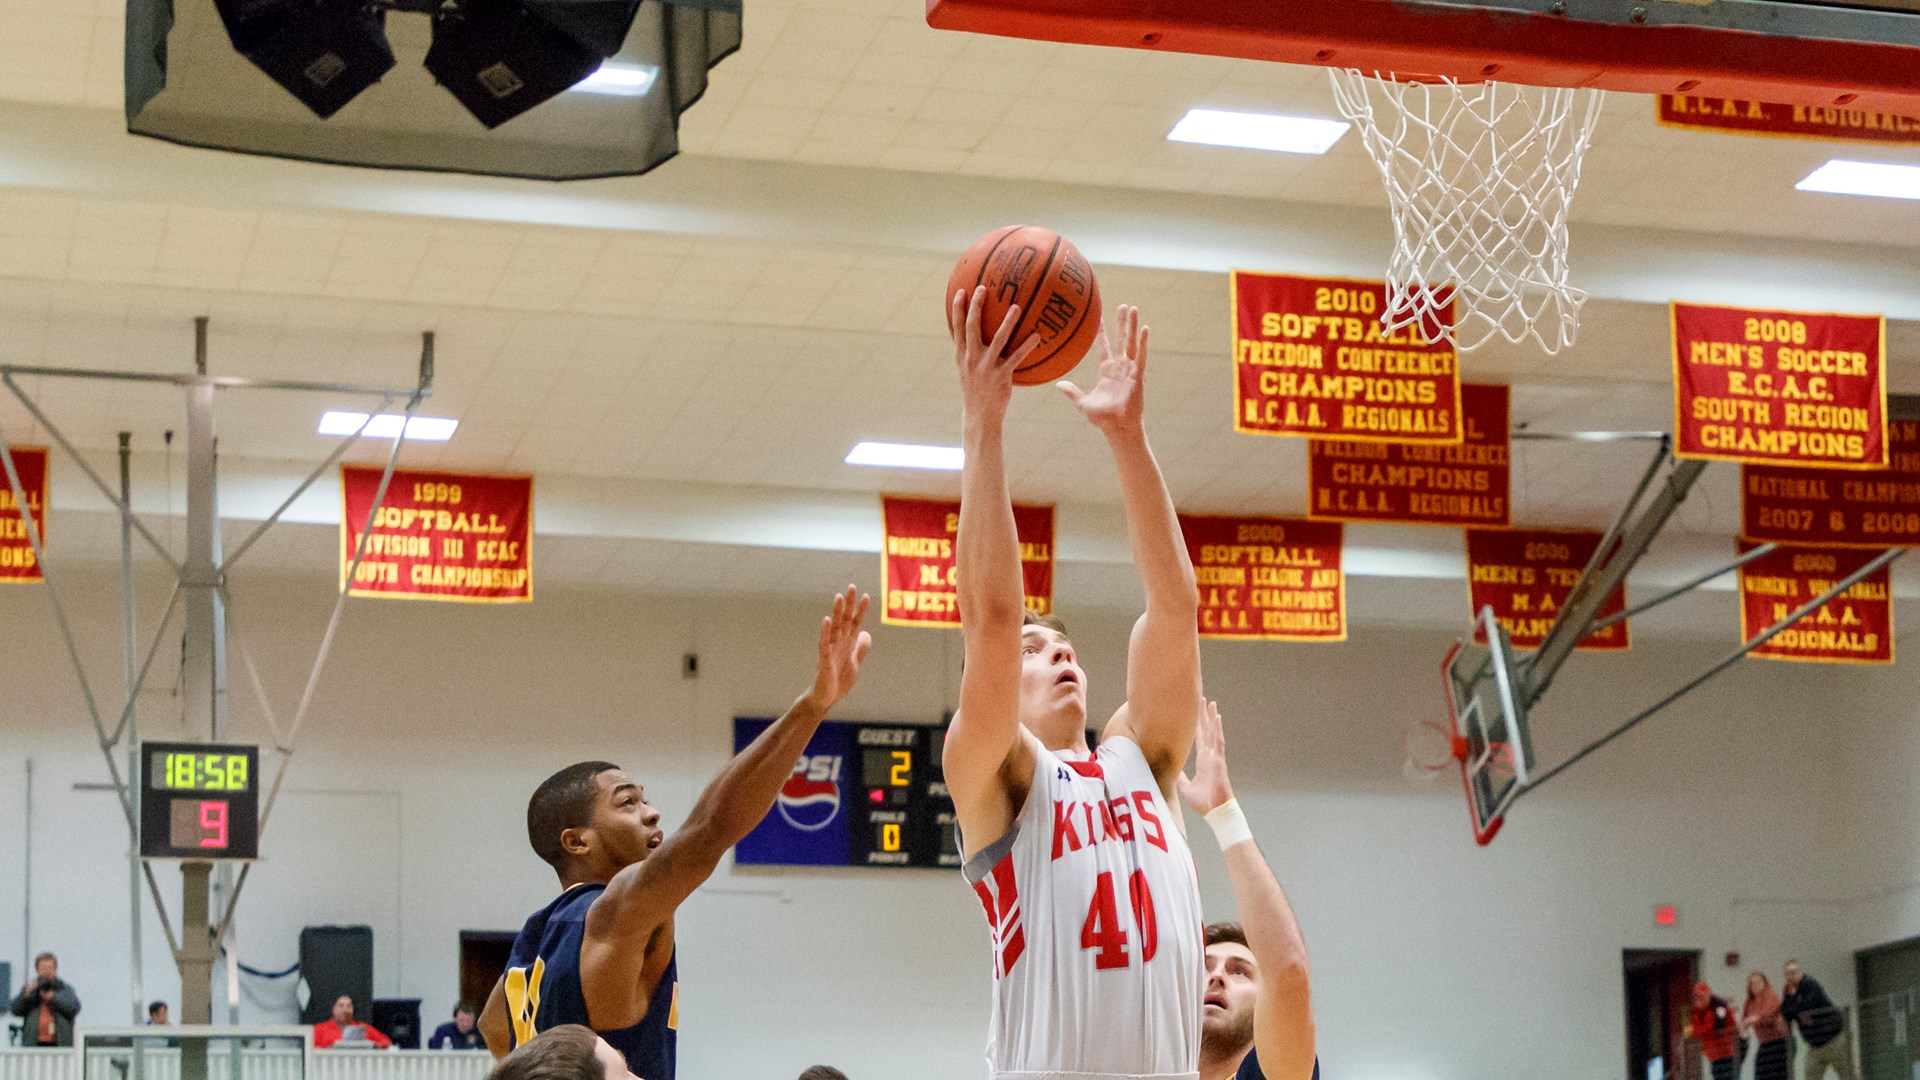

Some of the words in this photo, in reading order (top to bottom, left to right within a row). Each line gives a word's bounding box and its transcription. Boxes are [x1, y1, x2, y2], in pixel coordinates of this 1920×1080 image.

[1315, 287, 1376, 314] 2010
[1262, 312, 1428, 347] SOFTBALL
[1744, 318, 1807, 344] 2008
[1239, 339, 1323, 369] FREEDOM
[1337, 347, 1452, 375] CONFERENCE
[1690, 341, 1764, 369] MEN'S
[1777, 347, 1868, 377] SOCCER
[1260, 371, 1436, 404] CHAMPIONS
[1728, 370, 1834, 401] E.C.A.C.
[1245, 399, 1327, 428] N.C.A.A.
[1343, 404, 1449, 433] REGIONALS
[1692, 396, 1770, 425] SOUTH
[1785, 403, 1869, 432] REGION
[1700, 424, 1865, 459] CHAMPIONS
[1332, 463, 1489, 491] CHAMPIONS
[1749, 475, 1829, 499] NATIONAL
[413, 483, 462, 505] 1999
[1410, 493, 1503, 518] REGIONALS
[372, 507, 506, 534] SOFTBALL
[1759, 506, 1814, 531] 2007
[443, 538, 464, 559] III
[476, 540, 519, 561] ECAC
[1201, 545, 1322, 566] SOFTBALL
[411, 564, 528, 589] CHAMPIONSHIP
[1252, 567, 1304, 588] LEAGUE
[1311, 569, 1338, 588] AND
[1251, 589, 1334, 610] CHAMPIONS
[1263, 610, 1339, 631] REGIONALS
[165, 753, 248, 790] 18:58
[788, 754, 842, 782] PSI
[890, 751, 911, 786] 2
[199, 801, 228, 849] 9
[883, 824, 900, 852] 0
[1051, 791, 1168, 863] KINGS
[1080, 868, 1158, 970] 40
